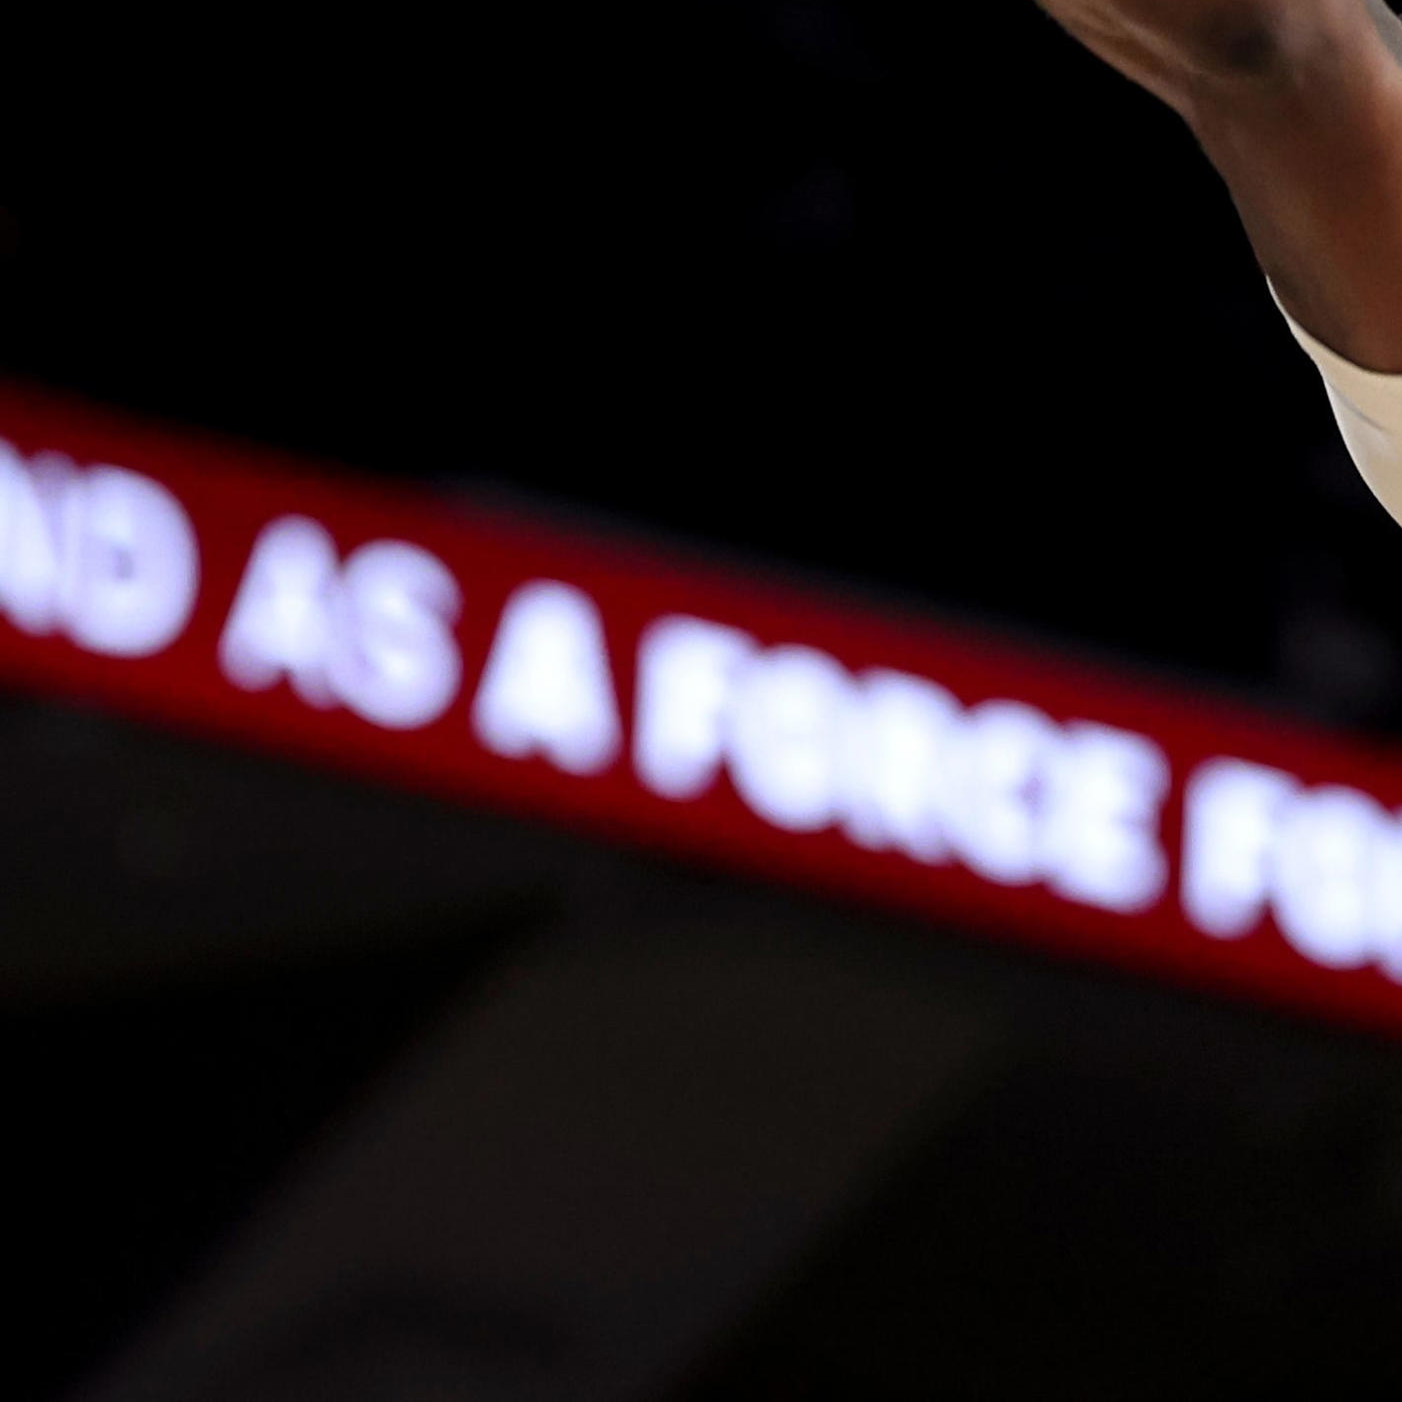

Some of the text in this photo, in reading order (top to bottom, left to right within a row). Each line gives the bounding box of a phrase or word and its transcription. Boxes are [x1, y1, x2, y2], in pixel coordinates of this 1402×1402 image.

[217, 513, 463, 732] AS
[471, 578, 623, 776] A
[631, 612, 1171, 916] FORCE
